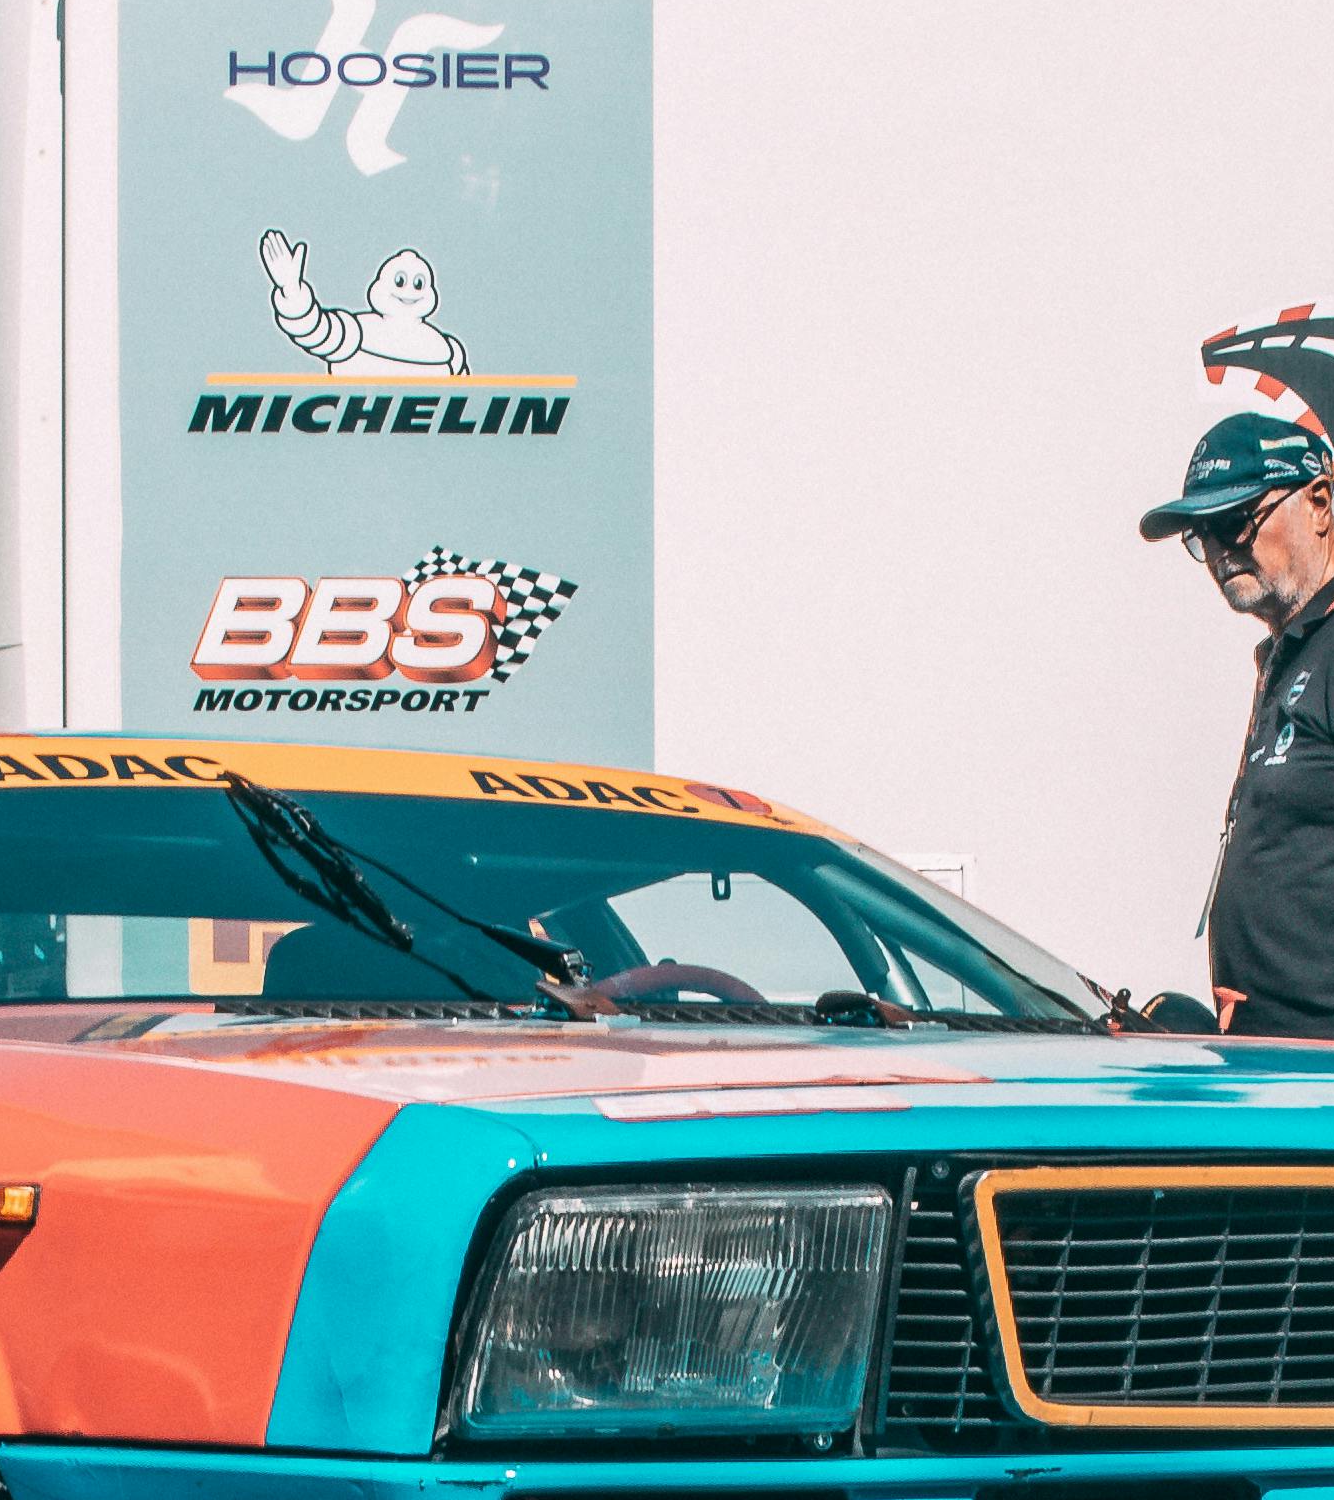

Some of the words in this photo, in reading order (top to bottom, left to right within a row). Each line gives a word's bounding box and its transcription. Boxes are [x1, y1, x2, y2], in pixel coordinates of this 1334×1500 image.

[228, 50, 551, 90] HOOSIER
[188, 394, 572, 436] MICHELIN
[190, 575, 506, 684] BBS
[193, 689, 490, 713] MOTORSPORT
[469, 769, 700, 814] ADAC
